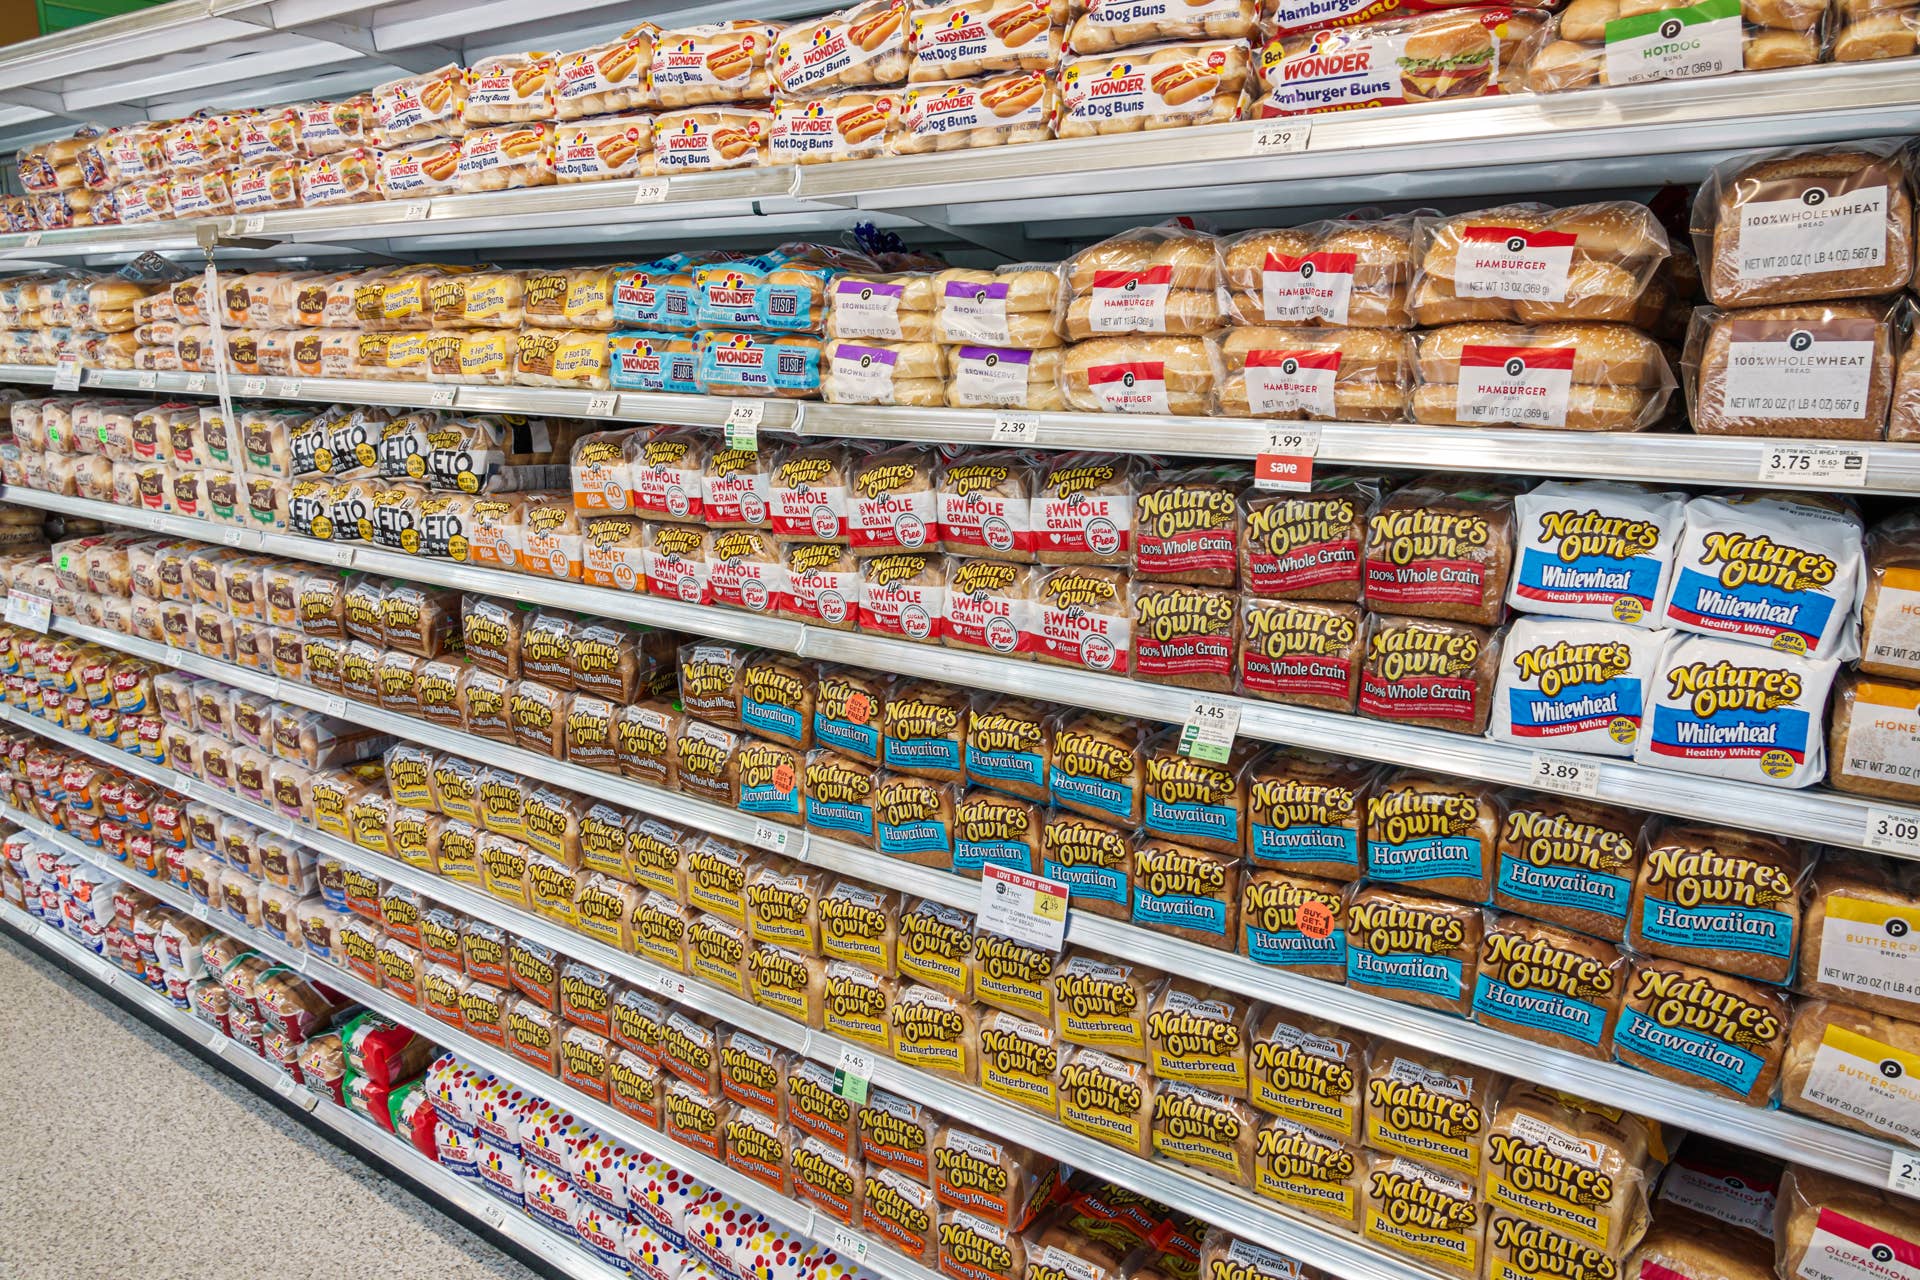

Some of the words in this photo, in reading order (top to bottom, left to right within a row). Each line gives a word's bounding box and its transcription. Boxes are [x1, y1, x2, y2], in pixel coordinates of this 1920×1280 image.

[803, 36, 847, 66] WONDER
[919, 48, 938, 63] Hot
[937, 47, 957, 61] Dog
[959, 44, 987, 56] Buns
[1264, 51, 1283, 65] 8ct
[1643, 39, 1701, 59] HOTDOG
[668, 56, 703, 67] WONDER
[1284, 53, 1370, 80] WONDER
[1676, 65, 1689, 76] OZ
[787, 75, 804, 90] Hot
[806, 66, 826, 83] Dog
[827, 55, 851, 76] Buns
[1091, 77, 1145, 97] WONDER
[1350, 81, 1391, 96] Buns
[791, 118, 833, 133] WONDER
[670, 136, 709, 149] WONDER
[773, 138, 789, 150] Hot
[790, 138, 808, 152] Dog
[810, 138, 834, 150] Buns
[1257, 132, 1292, 146] 4.29
[641, 187, 660, 198] 3.79
[1475, 259, 1547, 271] HAMBURGER
[1279, 288, 1333, 298] HAMBURGER
[717, 350, 762, 364] WONDER
[783, 357, 801, 373] USO
[741, 371, 767, 383] Buns
[1478, 385, 1547, 397] HAMBURGER
[591, 399, 608, 409] 3.79
[1472, 406, 1487, 416] NET
[1512, 408, 1523, 417] OZ
[1730, 397, 1745, 409] NET
[1748, 397, 1761, 409] WT
[1762, 398, 1773, 409] 20
[1775, 399, 1787, 410] OZ
[1798, 399, 1809, 410] LB
[1811, 399, 1818, 410] 4
[1819, 400, 1833, 412] OZ)
[1834, 400, 1851, 411] 567
[1853, 402, 1860, 413] g
[733, 408, 753, 419] 4.29
[1000, 422, 1026, 433] 2.39
[1270, 435, 1302, 447] 1.99
[1270, 462, 1298, 474] save
[1770, 455, 1811, 470] 3.75
[1048, 466, 1114, 489] Nature's
[1059, 477, 1096, 499] Own
[864, 499, 913, 514] WHOLE
[1053, 501, 1109, 517] WHOLE
[862, 516, 891, 526] GRAIN
[1047, 519, 1083, 529] GRAIN
[1370, 508, 1488, 547] Nature's
[1539, 512, 1660, 547] Nature's
[1091, 535, 1116, 546] Free
[1560, 535, 1625, 561] Own
[1391, 535, 1457, 565] Own
[616, 567, 631, 580] 40
[1368, 569, 1395, 581] 100%
[1396, 568, 1438, 583] Whole
[1440, 568, 1480, 585] Grain
[1541, 565, 1632, 591] Whitewheat
[1547, 591, 1585, 603] Healthy
[1586, 593, 1615, 603] White
[1247, 661, 1271, 673] 100%
[1271, 662, 1308, 677] Whole
[1309, 665, 1346, 681] Grain
[1668, 661, 1801, 699] Nature's
[745, 666, 803, 699] Nature's
[1195, 704, 1224, 720] 4.45
[1693, 689, 1767, 717] Own
[746, 701, 796, 726] Hawaiian
[1677, 721, 1777, 744] Whitewheat
[1874, 719, 1920, 734] HONE
[1055, 732, 1134, 772] Nature's
[1685, 748, 1727, 759] Healthy
[1729, 748, 1761, 757] White
[1767, 752, 1785, 761] SOFT
[1065, 754, 1111, 780] Own
[1539, 762, 1579, 780] 3.89
[1850, 758, 1867, 769] NET
[1869, 760, 1884, 771] WT
[1885, 763, 1897, 774] 20
[1898, 765, 1912, 777] OZ
[1056, 772, 1123, 803] Hawaiian
[884, 826, 938, 841] Hawaiian
[1877, 820, 1919, 840] 3.09
[1373, 843, 1469, 865] Hawaiian
[996, 870, 1011, 880] LOVE
[1012, 875, 1021, 884] TO
[1022, 878, 1036, 889] SAVE
[1648, 848, 1791, 896] Nature's
[694, 885, 739, 909] Butterbread
[1676, 877, 1757, 907] Own
[819, 899, 886, 931] Nature's
[1657, 906, 1776, 938] Hawaiian
[826, 935, 881, 955] Butterbread
[1824, 967, 1840, 978] NET
[1841, 971, 1855, 982] WT
[1638, 970, 1779, 1040] Nature's
[1067, 1017, 1134, 1034] Butterbread
[1301, 1040, 1336, 1054] FLORIDA
[1628, 1016, 1744, 1074] Hawaiian
[844, 1054, 864, 1068] 4.45
[1422, 1074, 1459, 1091] FLORIDA
[1369, 1080, 1480, 1130] Nature's
[790, 1106, 817, 1129] Honey
[817, 1120, 845, 1140] Wheat
[859, 1108, 926, 1145] Nature's
[1391, 1106, 1450, 1137] Own
[873, 1127, 910, 1150] Own
[1378, 1126, 1469, 1159] Butterbread
[864, 1142, 893, 1162] Honey
[893, 1151, 924, 1168] Wheat
[630, 1190, 675, 1229] WONDER
